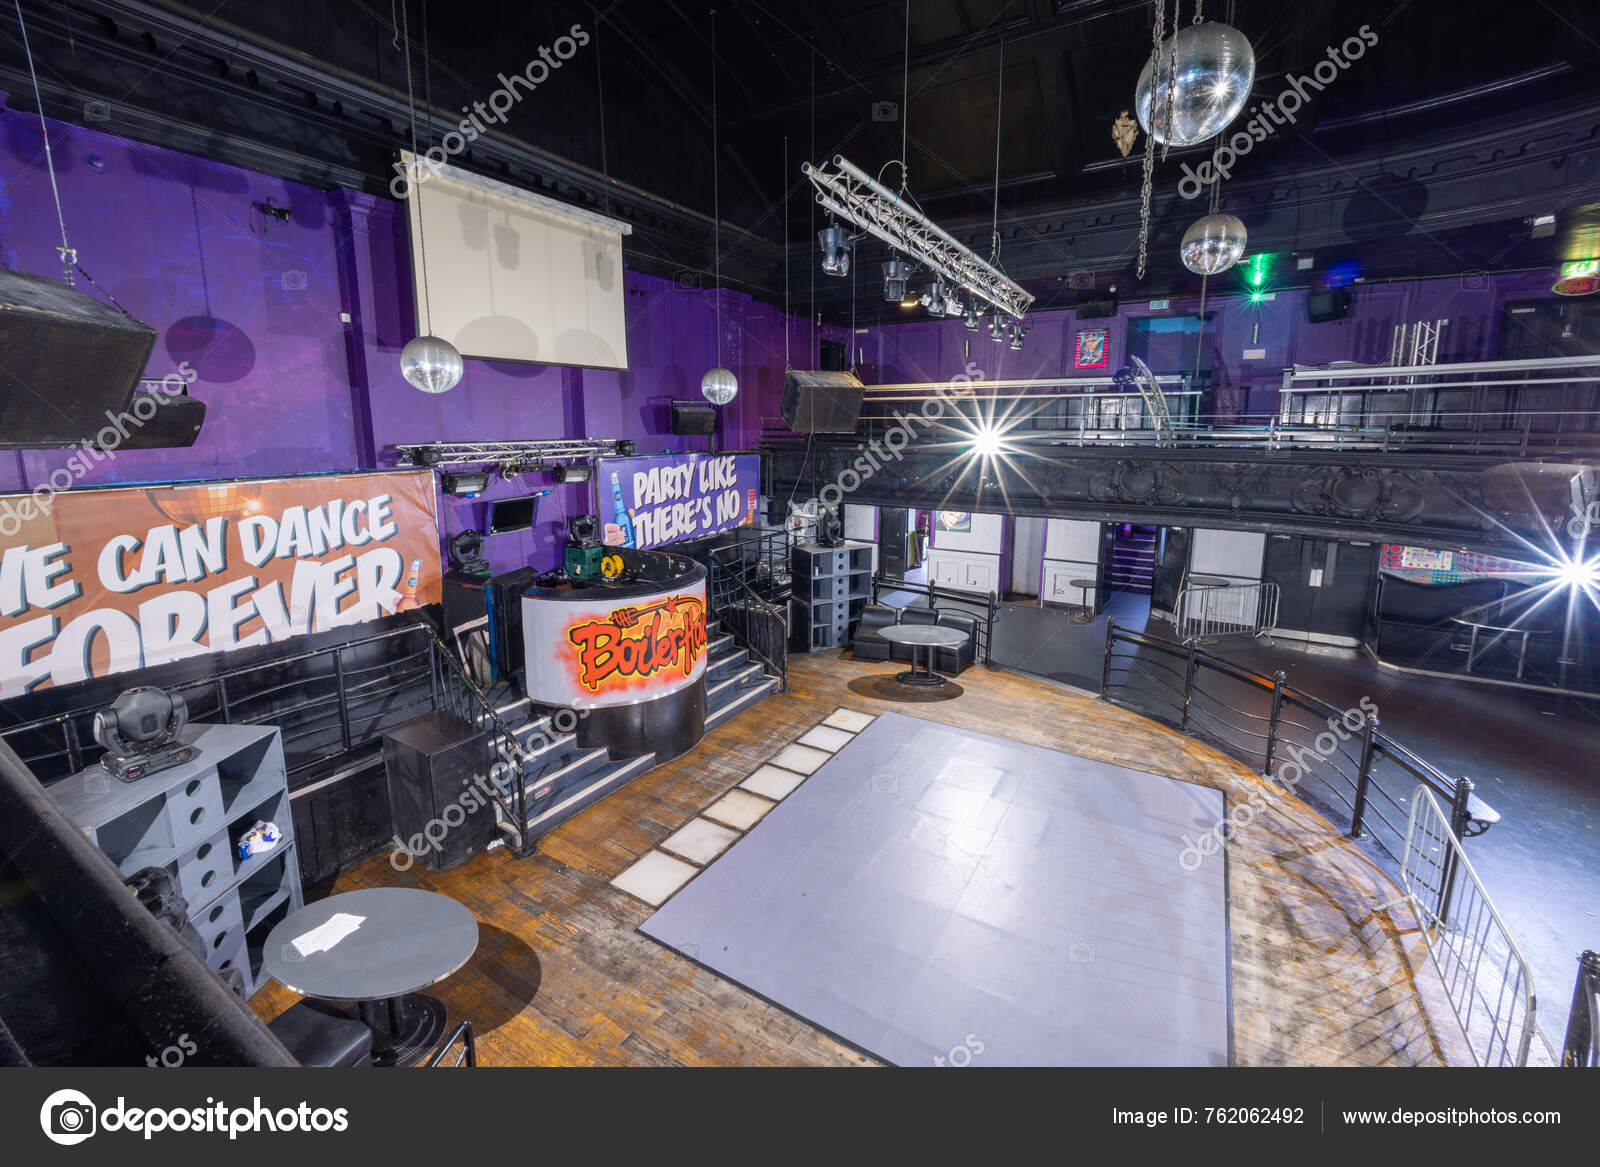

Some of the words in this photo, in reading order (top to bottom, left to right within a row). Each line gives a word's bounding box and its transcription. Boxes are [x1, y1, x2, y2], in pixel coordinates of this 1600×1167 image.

[631, 495, 714, 550] THERE'S
[717, 489, 741, 527] NO
[633, 462, 697, 510] PARTY
[699, 455, 738, 495] LIKE
[97, 516, 227, 594] CAN
[238, 494, 398, 568] DANCE
[0, 547, 403, 695] FOREVER
